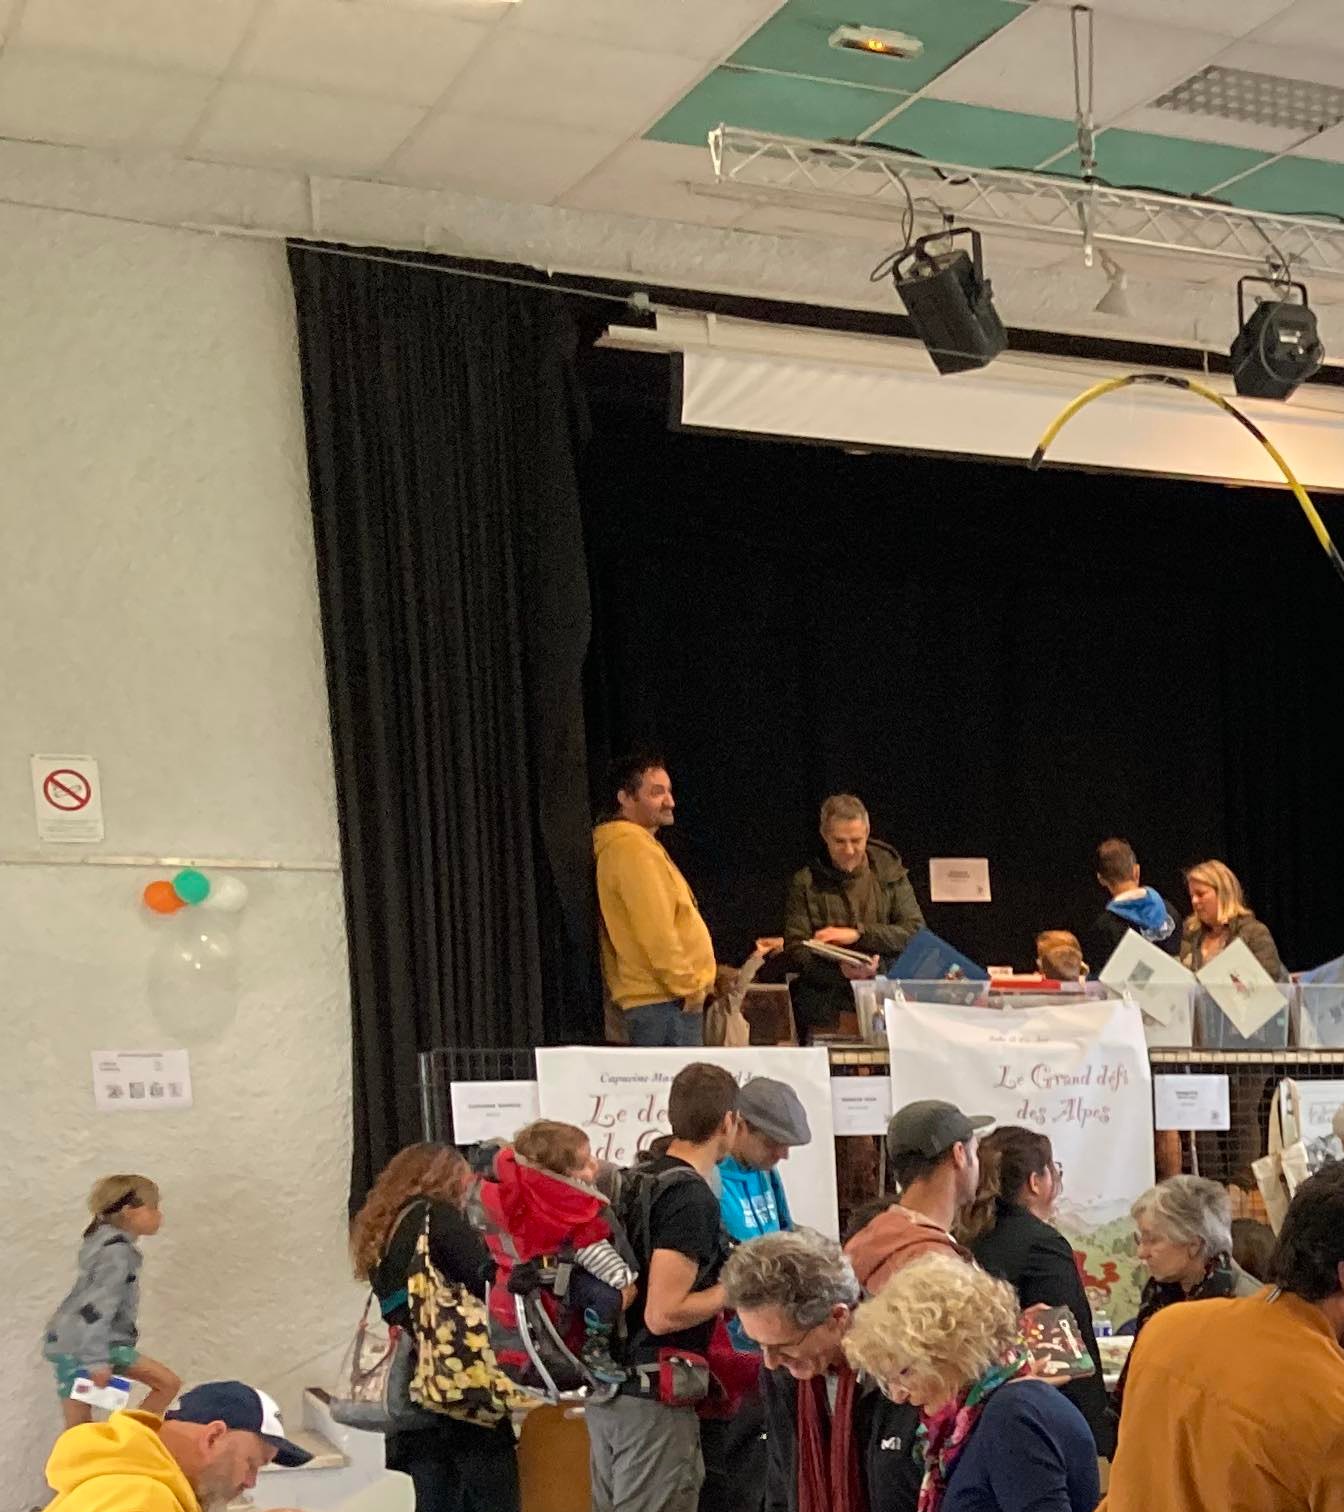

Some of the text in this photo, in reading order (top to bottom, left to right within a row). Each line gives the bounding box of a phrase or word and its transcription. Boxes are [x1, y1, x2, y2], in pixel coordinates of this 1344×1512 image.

[993, 1062, 1129, 1093] Le Grand défi
[583, 1094, 628, 1129] Le
[1016, 1096, 1112, 1129] des Alpes
[596, 1132, 625, 1161] de
